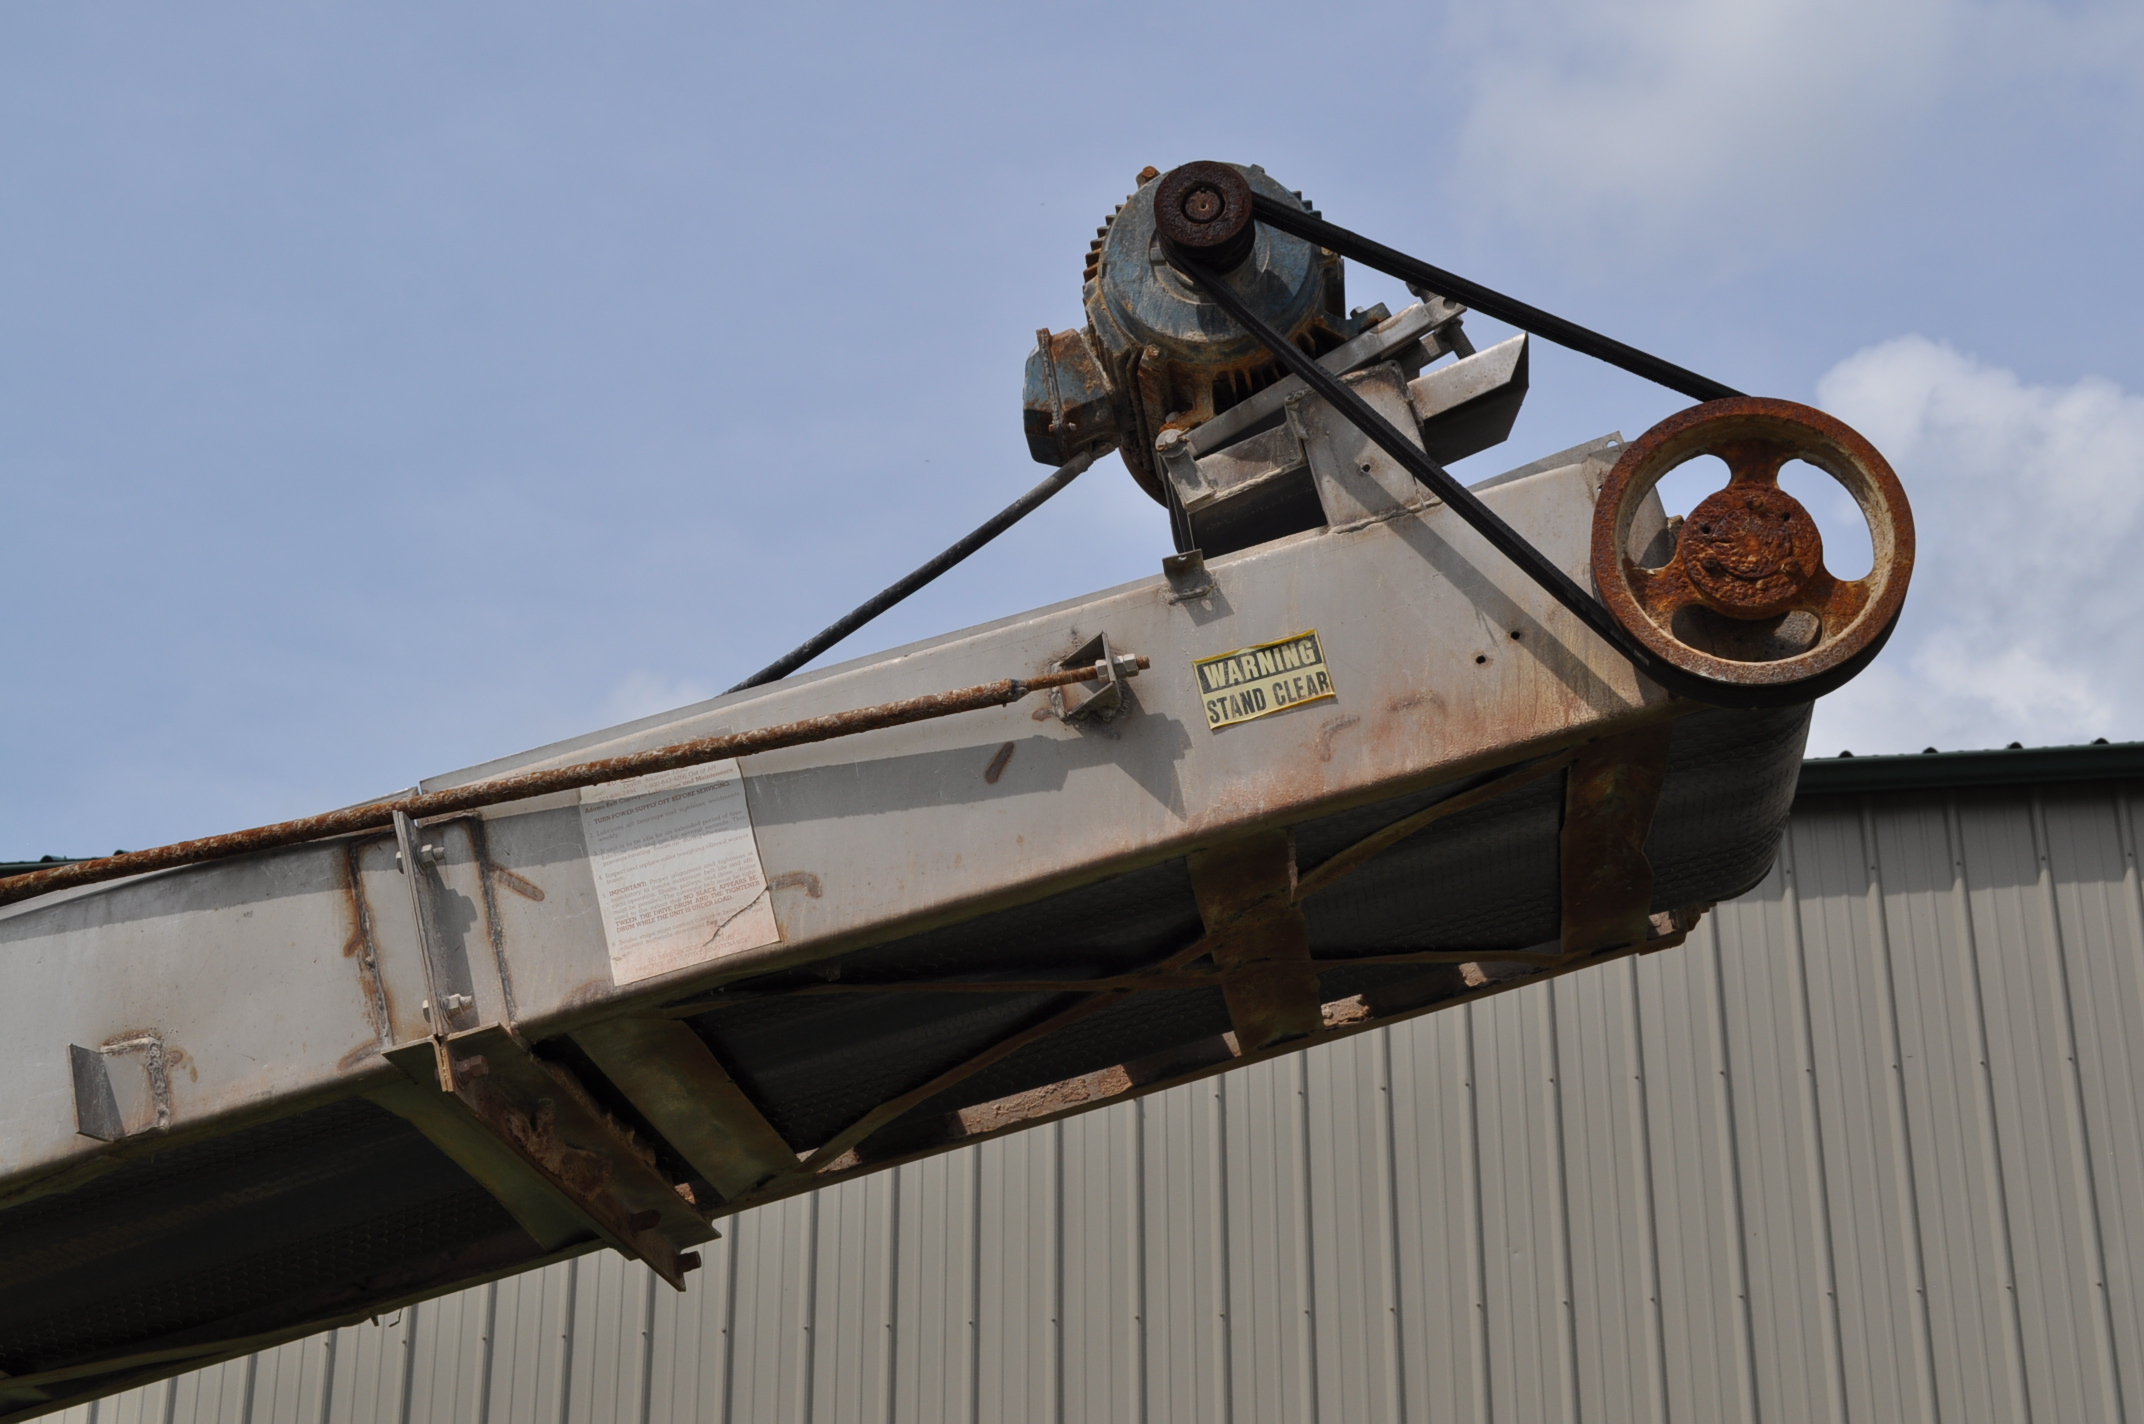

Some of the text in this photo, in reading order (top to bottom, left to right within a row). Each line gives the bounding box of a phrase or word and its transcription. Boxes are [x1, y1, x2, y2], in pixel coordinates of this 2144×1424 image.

[1203, 639, 1316, 689] WARNING
[1207, 671, 1330, 724] STAND CLEAR
[584, 766, 733, 814] Adams Belt Conveyor Lubrication and Maintenance
[688, 769, 699, 777] Out
[706, 764, 716, 772] AR
[594, 814, 611, 825] TURN
[611, 808, 634, 820] POWER
[634, 801, 657, 813] SUPPLY
[657, 797, 671, 806] OFF
[671, 790, 696, 802] BEFORE
[696, 780, 731, 795] SERVICING.
[596, 823, 624, 836] Lubricate
[636, 812, 663, 825] bearings
[664, 808, 677, 817] and
[708, 790, 740, 804] weldments
[606, 844, 618, 853] unit
[673, 820, 701, 833] extended
[702, 814, 721, 825] period
[680, 826, 703, 837] several
[732, 814, 745, 822] This
[602, 855, 628, 867] prevents
[628, 848, 651, 860] bearing
[605, 868, 626, 879] Inspect
[626, 864, 638, 873] and
[638, 858, 660, 869] replace
[727, 834, 742, 844] worn
[608, 880, 647, 896] IMPORTANT:
[648, 874, 669, 885] Proper
[670, 865, 701, 879] alignment
[703, 861, 715, 869] and
[717, 852, 746, 865] tightness
[610, 889, 641, 903] mandatory
[671, 871, 701, 885] maximum
[703, 867, 715, 876] belt
[728, 860, 741, 868] and
[611, 900, 626, 909] cient
[704, 874, 716, 883] and
[737, 863, 756, 873] drums
[613, 906, 627, 915] must
[663, 892, 675, 901] The
[675, 885, 702, 897] conveyor
[703, 881, 715, 889] belt
[716, 876, 731, 886] must
[638, 906, 648, 914] the
[649, 900, 668, 910] extent
[669, 896, 682, 904] that
[683, 892, 694, 900] NO
[695, 886, 716, 897] SLACK
[718, 876, 747, 890] APPEARS
[748, 873, 758, 881] BE-
[615, 880, 760, 927] TWEEN THE DRIVE DRUM AND THE TIGHTENER
[616, 922, 635, 933] DRUM
[635, 916, 656, 928] WHILE
[656, 913, 669, 922] THE
[669, 908, 684, 918] UNIT
[691, 900, 713, 911] UNDER
[713, 894, 734, 905] LOAD.
[656, 926, 671, 935] must
